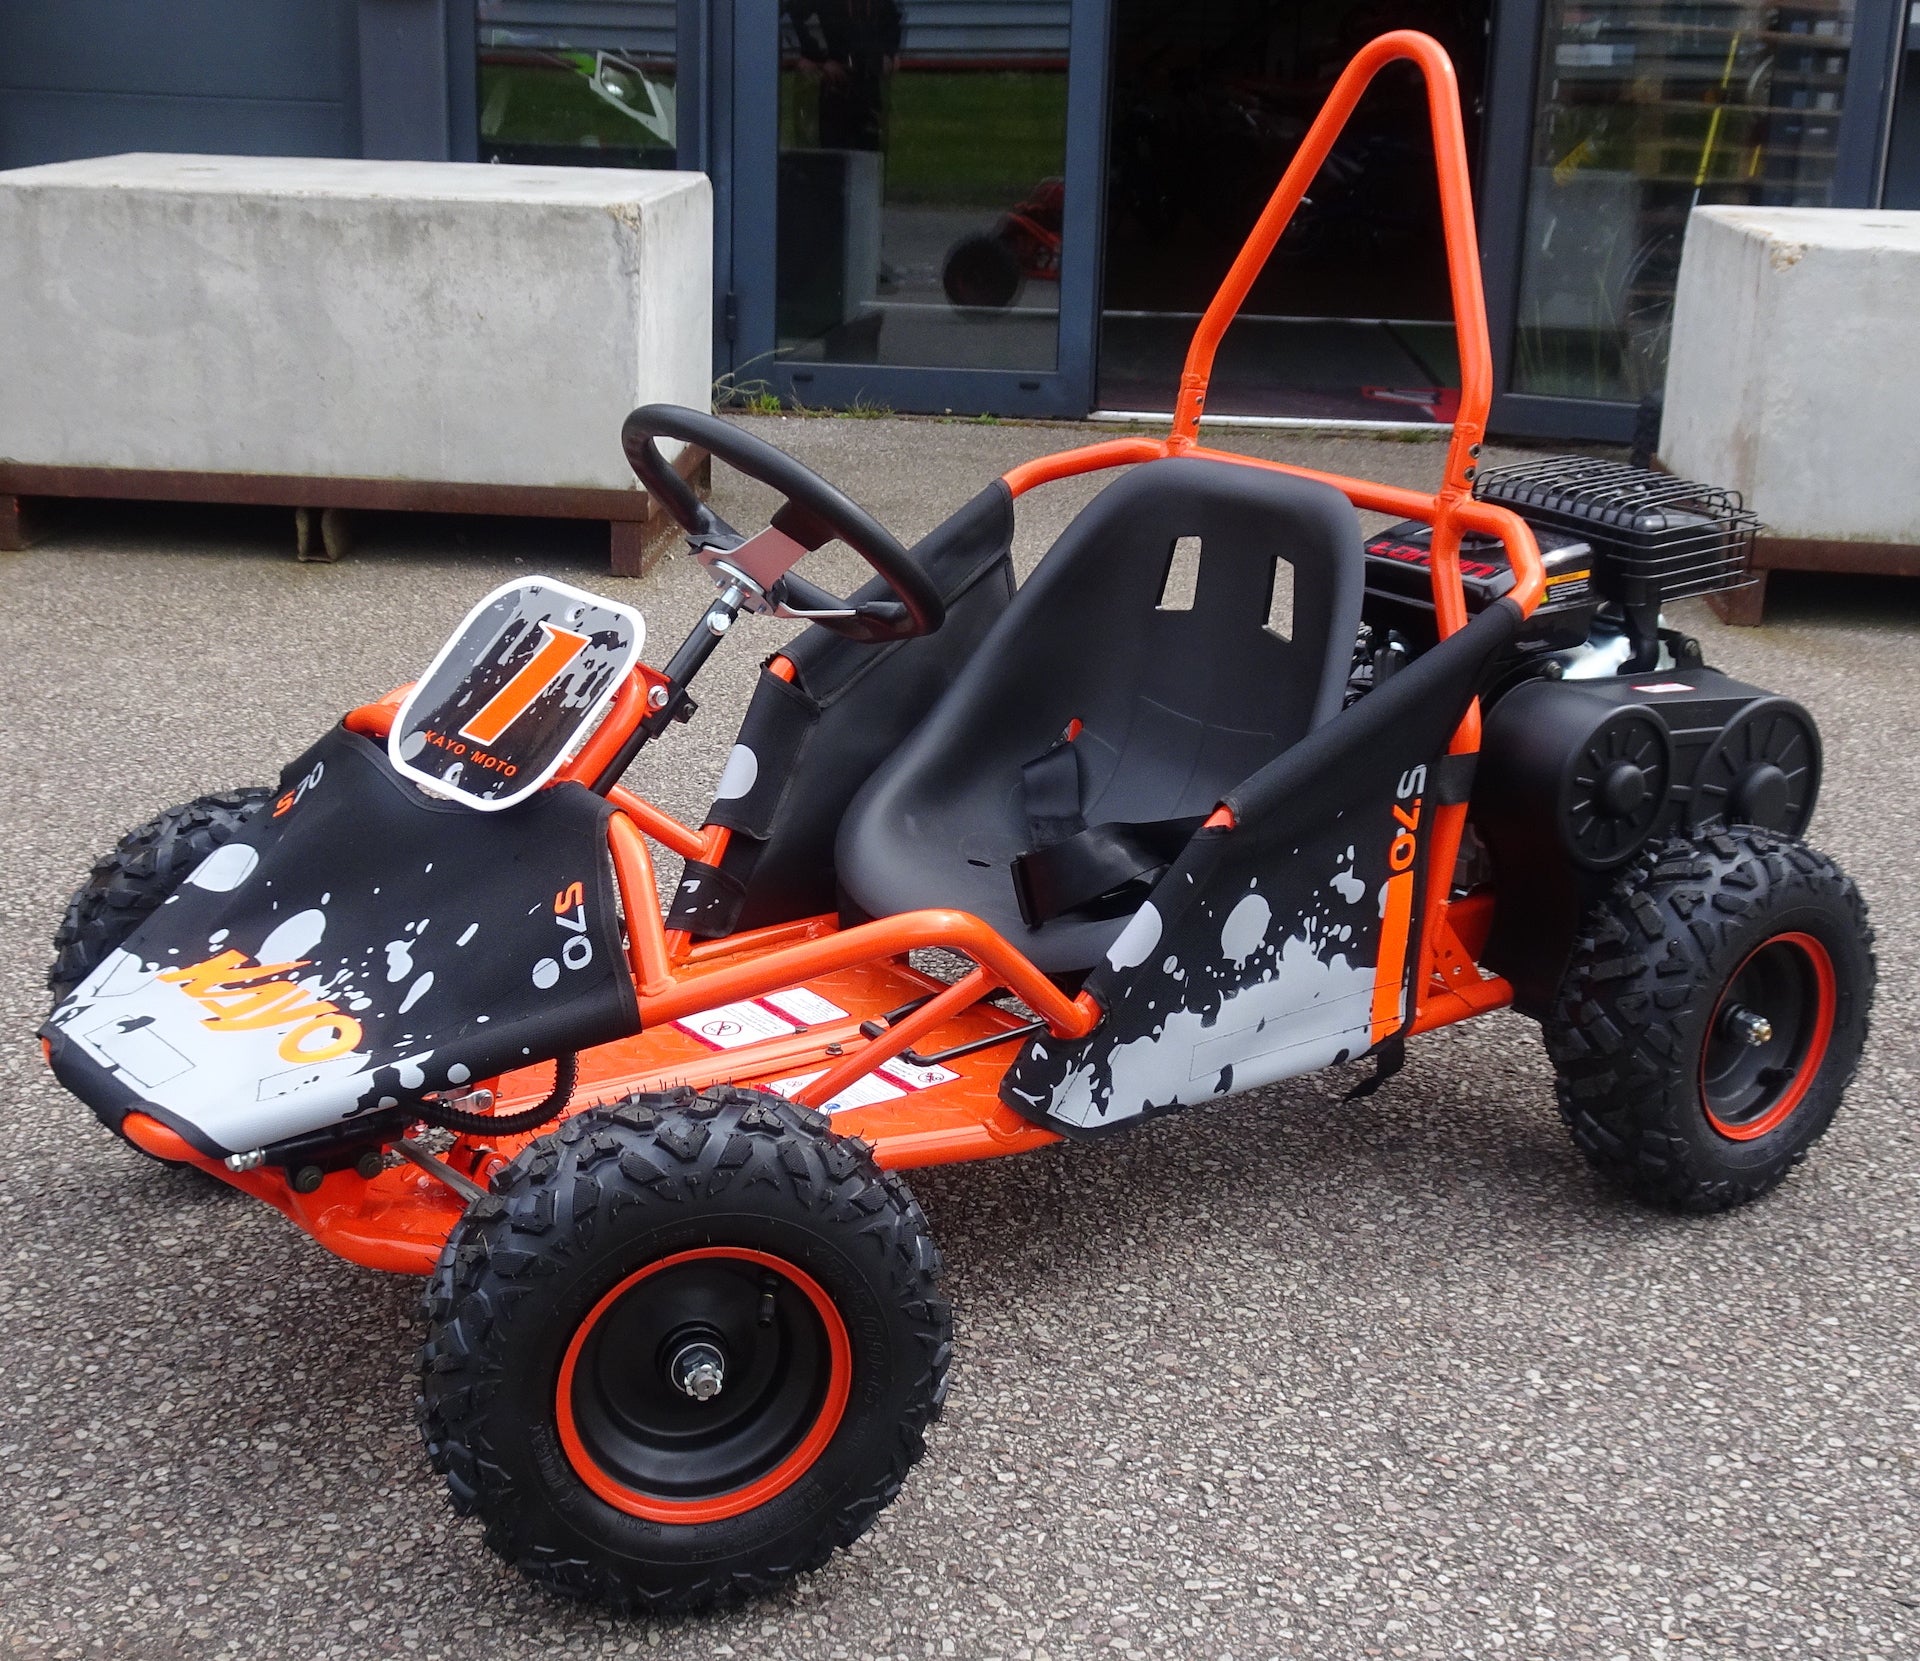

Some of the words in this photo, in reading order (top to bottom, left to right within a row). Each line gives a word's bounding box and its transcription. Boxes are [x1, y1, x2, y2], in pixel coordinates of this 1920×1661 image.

[458, 620, 593, 747] 1
[272, 761, 325, 818] S70
[423, 729, 467, 755] KAYO
[470, 750, 518, 777] MOTO
[1388, 763, 1427, 871] S70
[553, 881, 593, 970] S70
[156, 949, 363, 1064] KAYO
